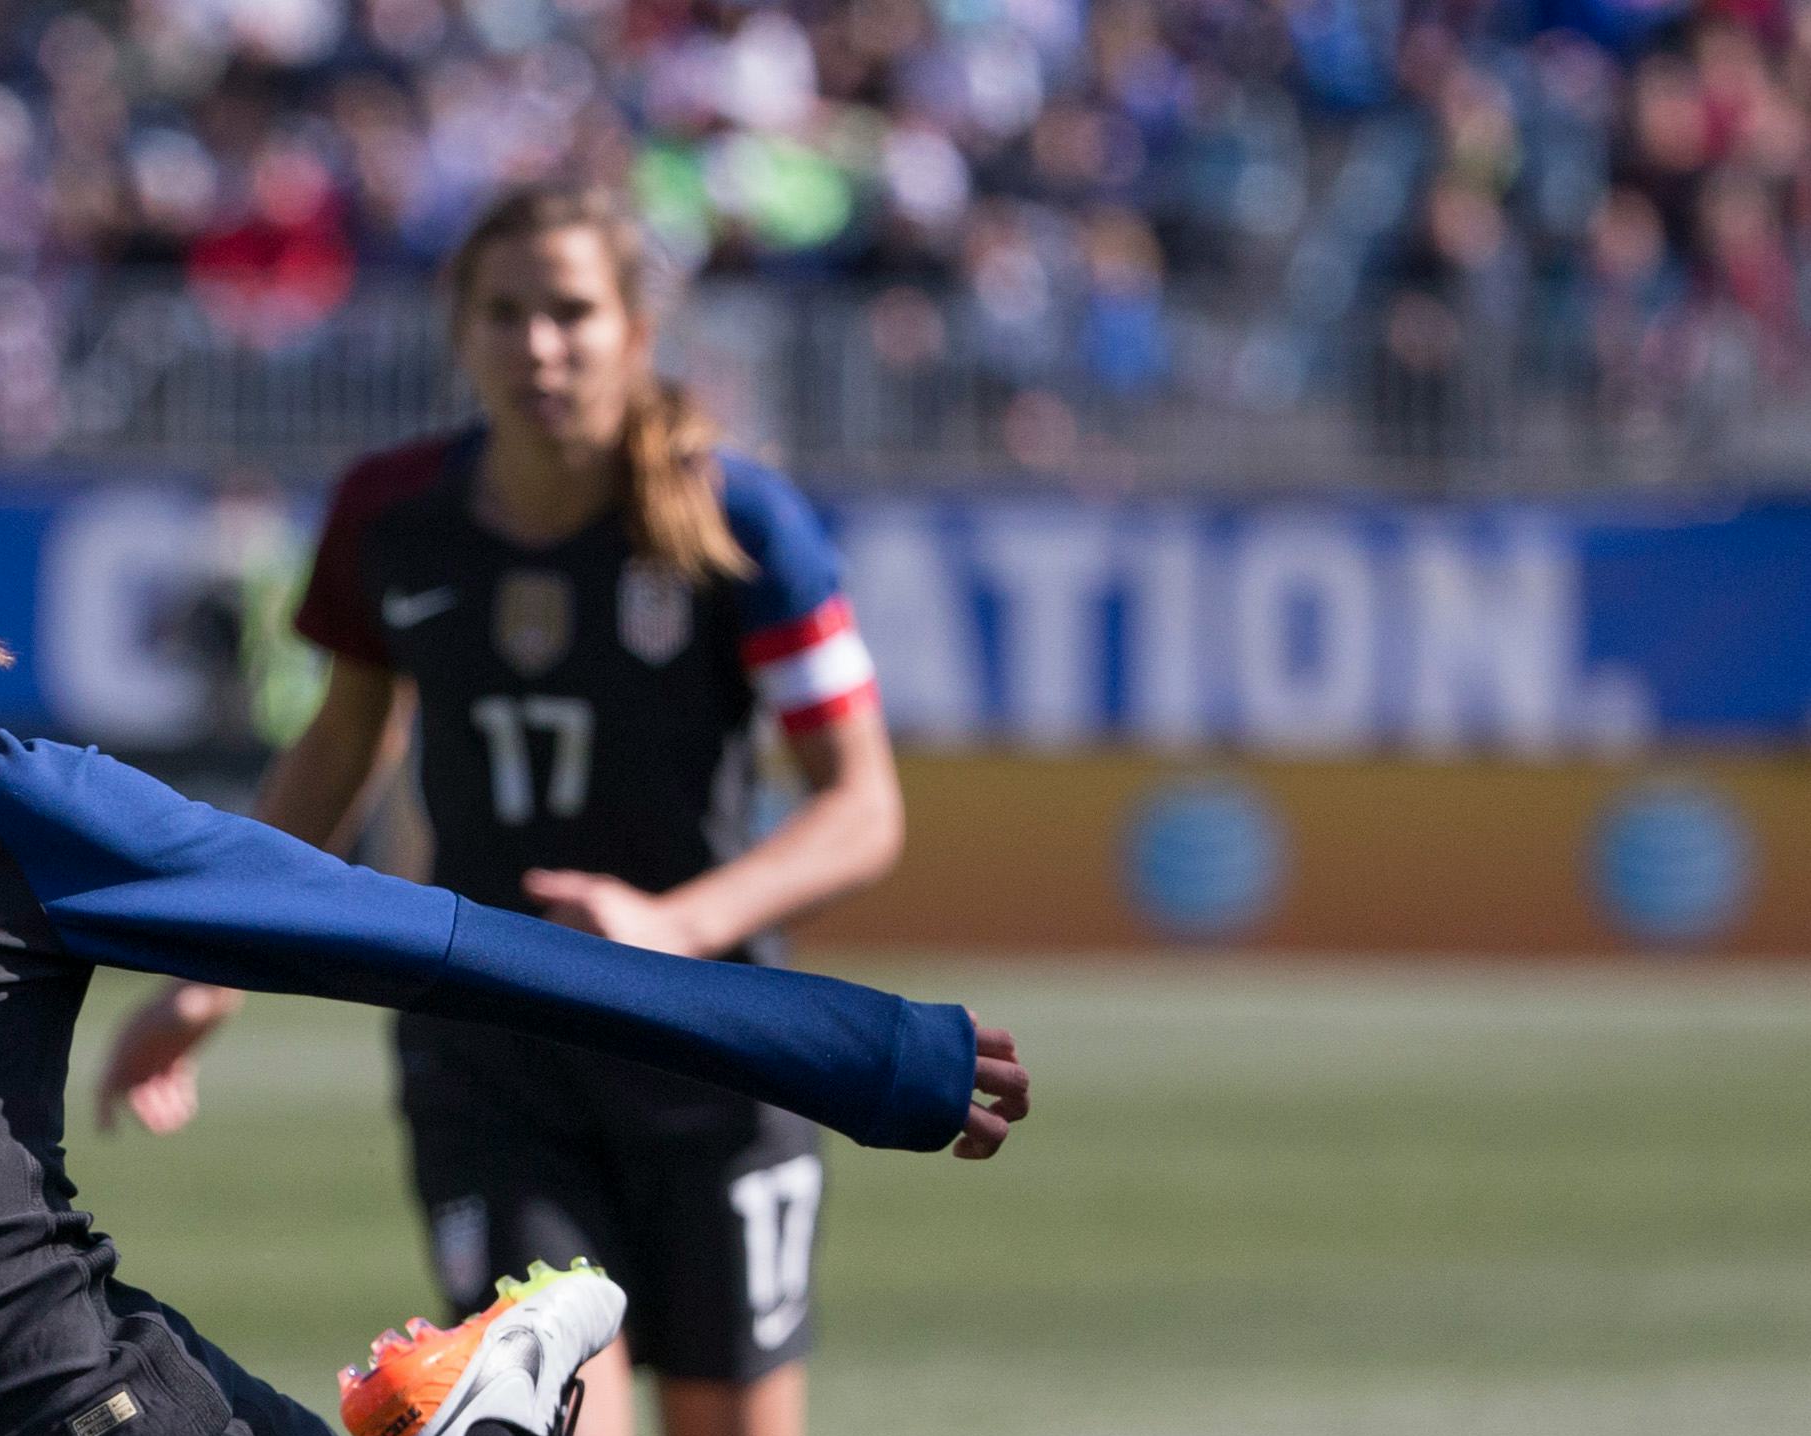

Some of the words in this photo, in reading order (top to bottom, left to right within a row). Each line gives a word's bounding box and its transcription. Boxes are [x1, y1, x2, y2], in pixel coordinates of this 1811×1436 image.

[841, 506, 1657, 752] ATION.
[473, 697, 592, 823] 17
[729, 1154, 823, 1314] 17
